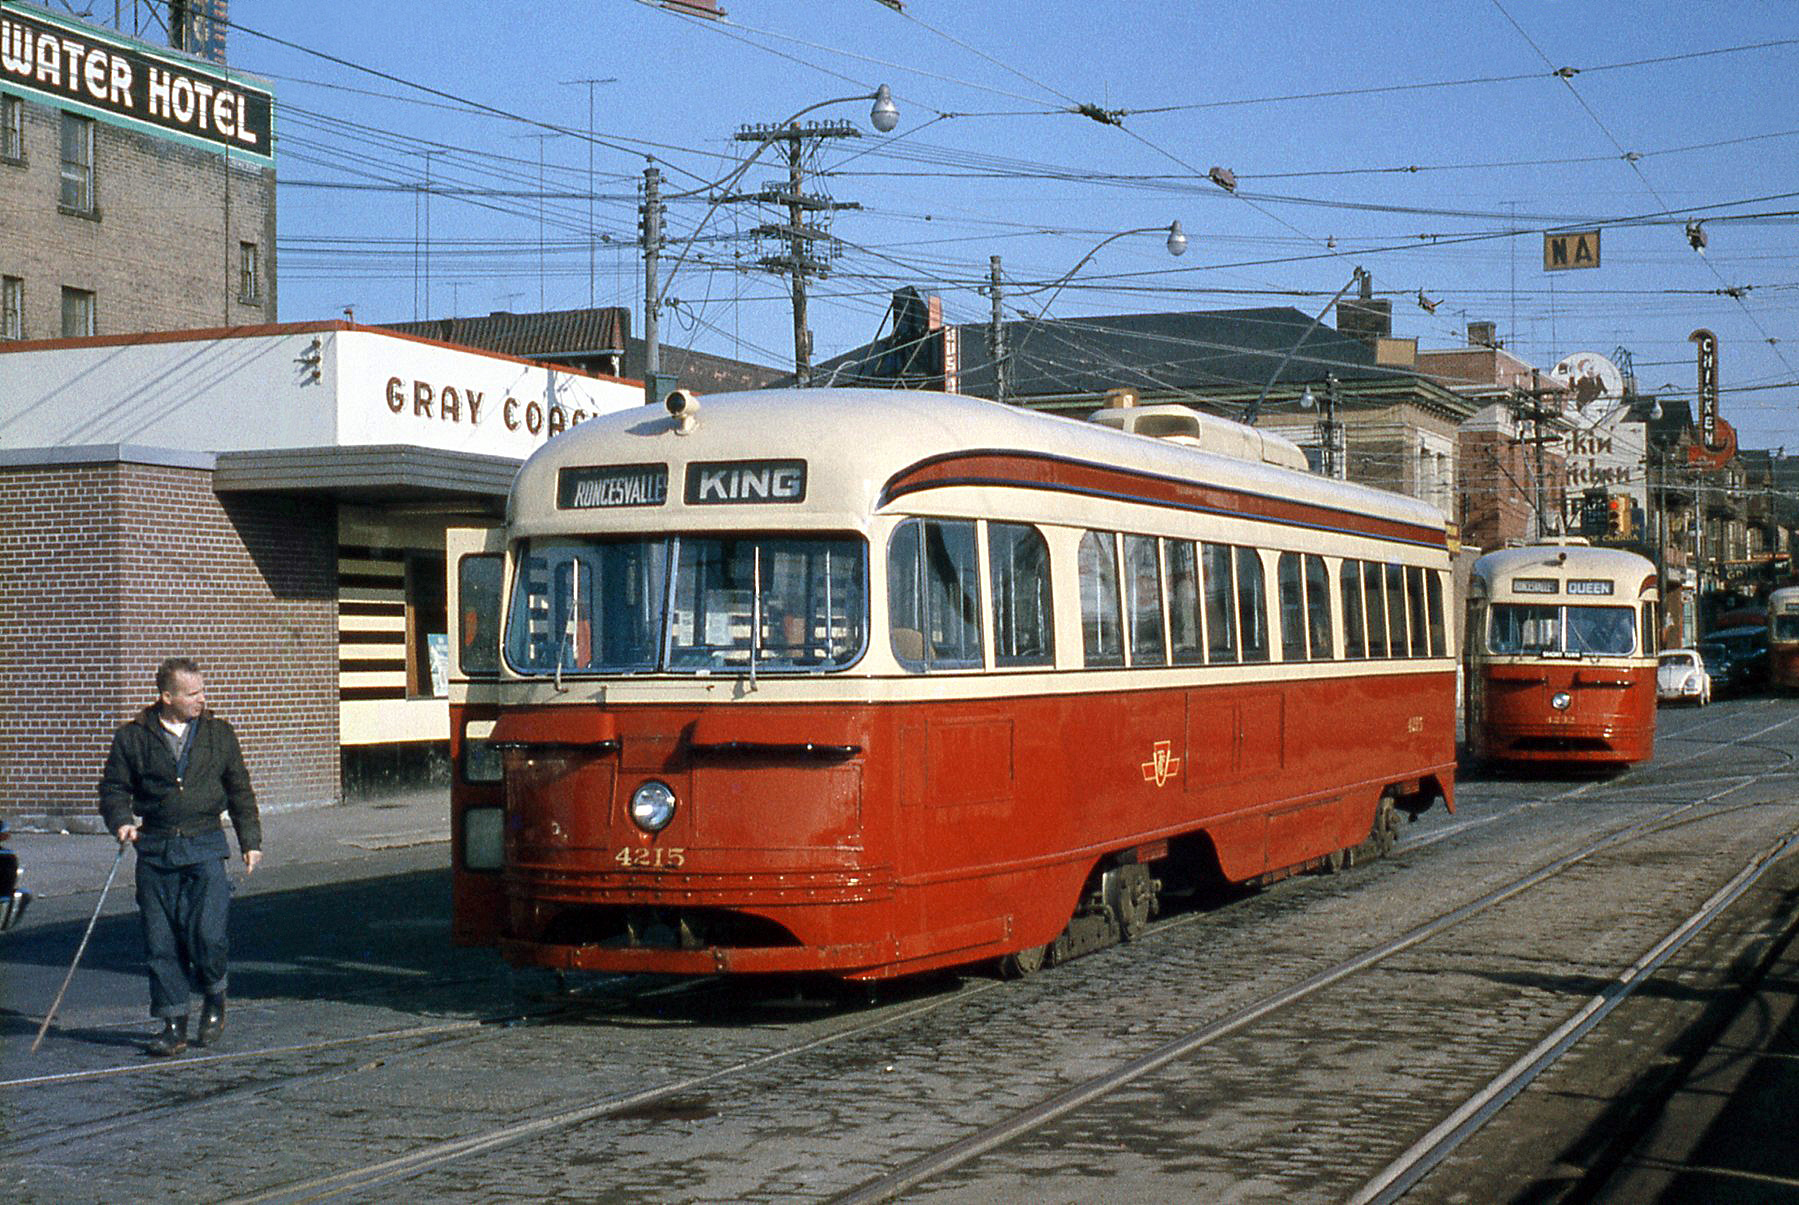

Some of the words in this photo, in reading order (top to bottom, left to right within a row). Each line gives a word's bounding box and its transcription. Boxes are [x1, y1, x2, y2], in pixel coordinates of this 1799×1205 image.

[1, 19, 134, 108] WATER
[149, 66, 257, 144] HOTEL
[386, 376, 485, 425] GRAY
[503, 396, 599, 437] COAC
[1702, 338, 1714, 446] CHICKEN
[699, 469, 801, 500] KING
[1568, 583, 1610, 594] QUEEN
[615, 847, 685, 866] 4215
